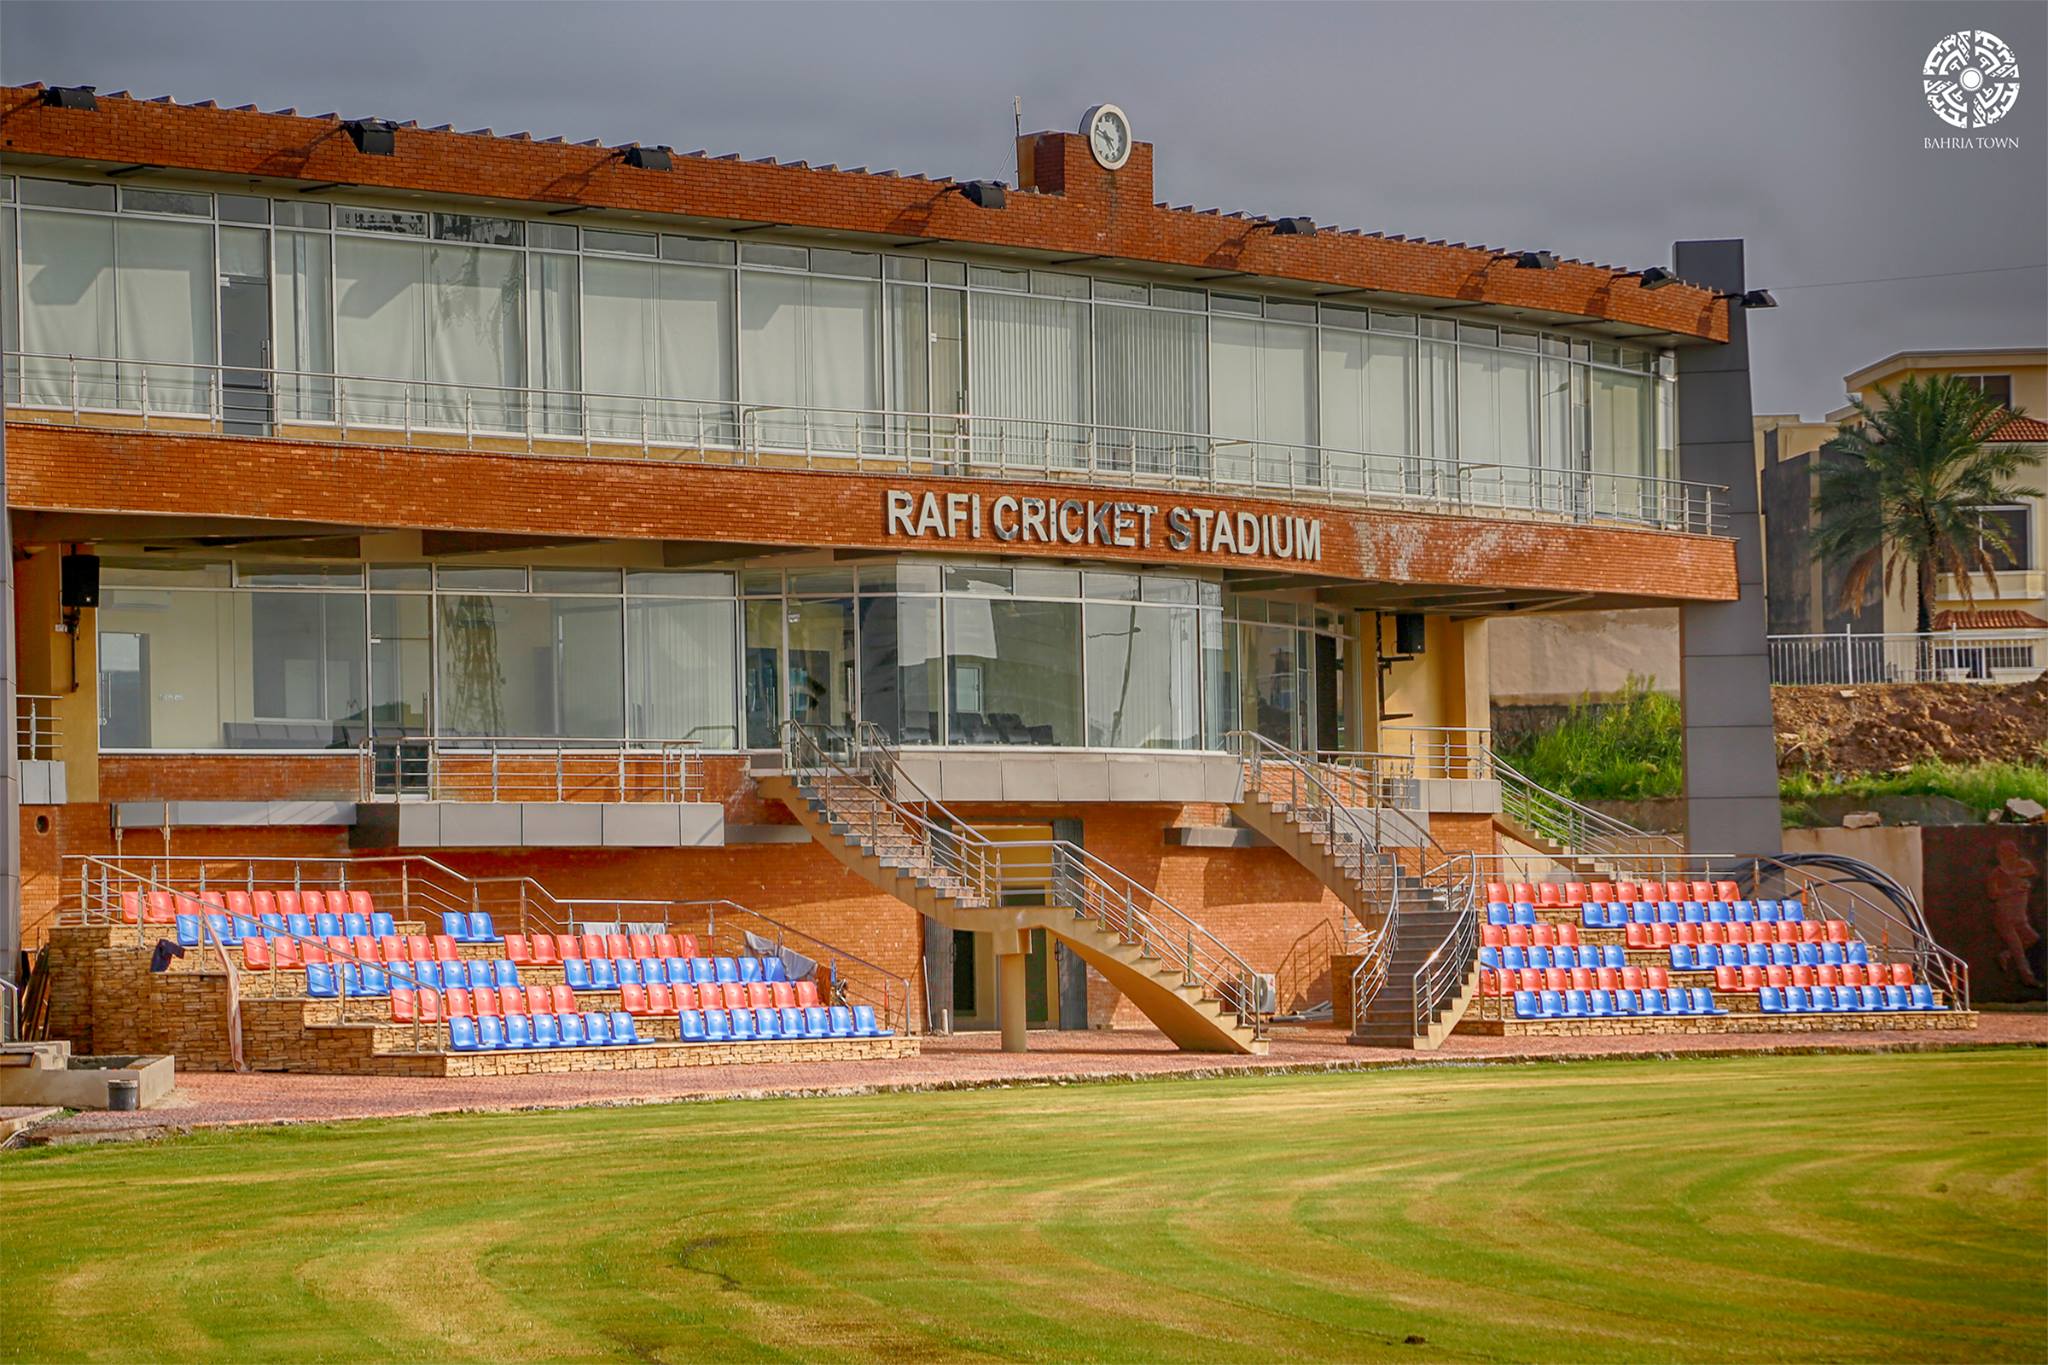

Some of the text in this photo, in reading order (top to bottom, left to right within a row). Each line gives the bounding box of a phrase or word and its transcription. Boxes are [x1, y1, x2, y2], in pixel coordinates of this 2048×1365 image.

[887, 490, 1322, 561] RAFI CRICKET STADIUM
